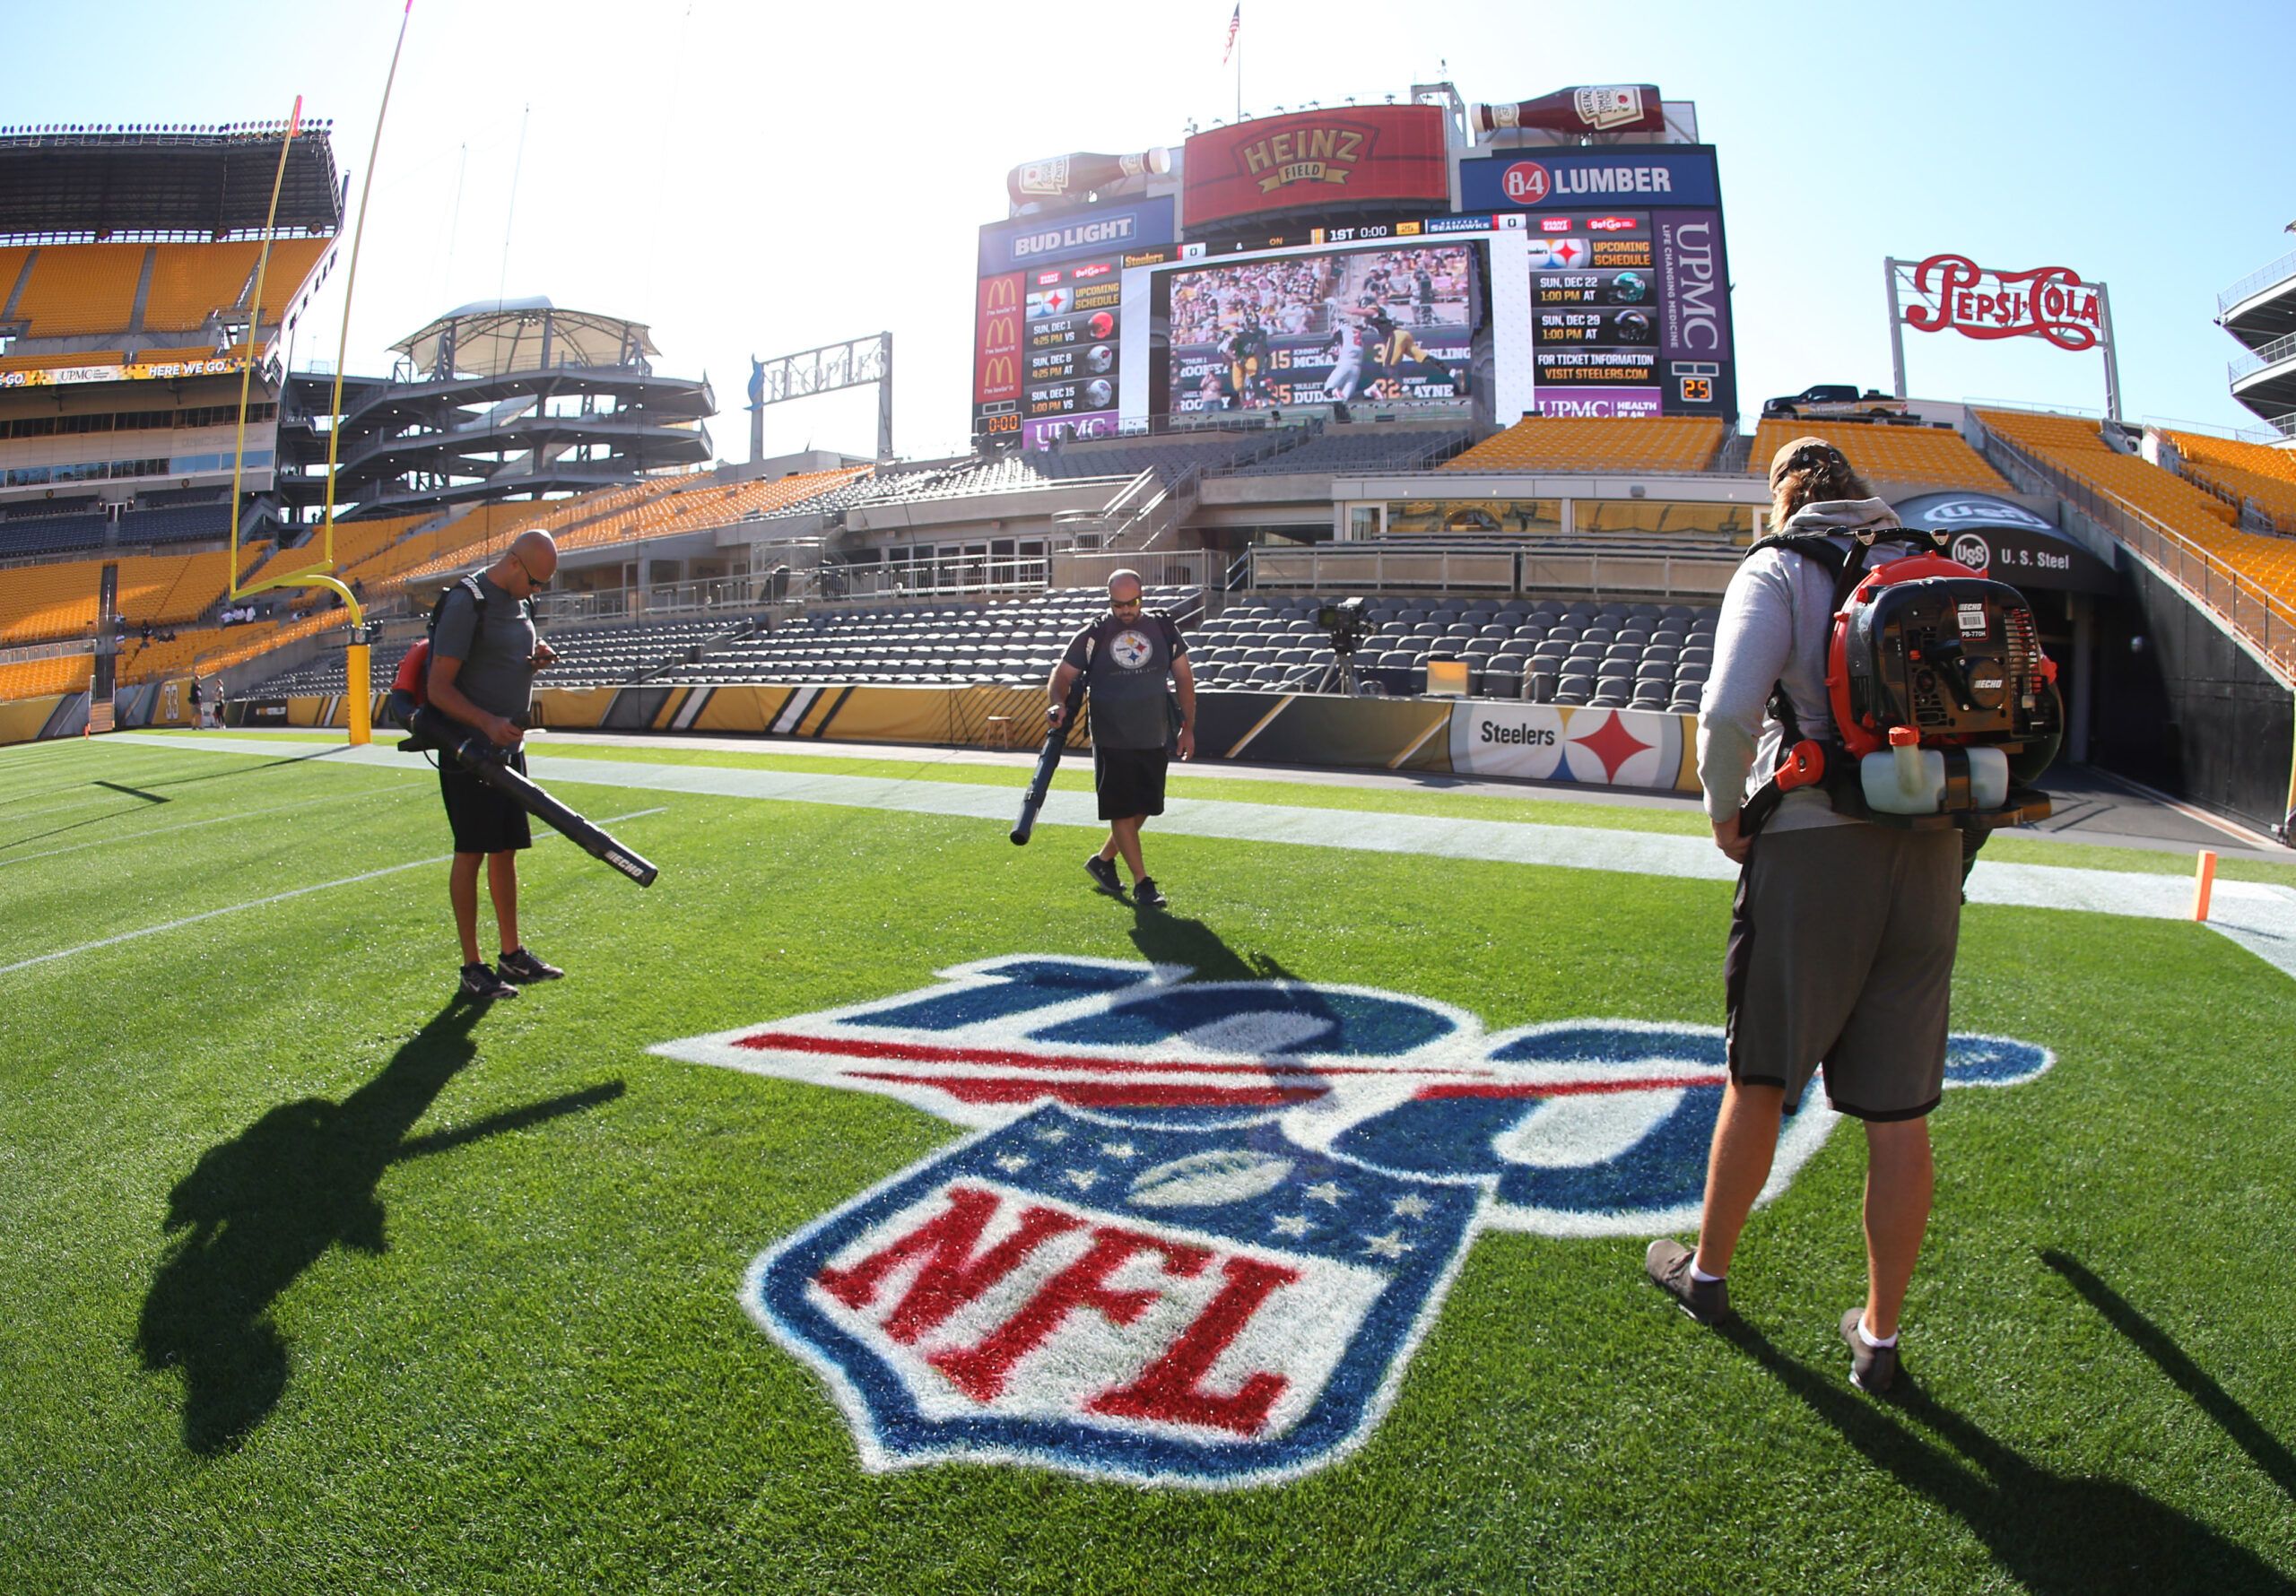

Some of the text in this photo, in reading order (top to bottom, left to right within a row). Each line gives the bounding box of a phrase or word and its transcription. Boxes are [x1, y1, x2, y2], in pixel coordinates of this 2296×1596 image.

[1243, 129, 1364, 175] HEINZ
[1284, 163, 1320, 179] FIELD
[1507, 168, 1672, 196] 84 LUMBER
[1330, 226, 1387, 241] 1ST 0:00
[1430, 222, 1491, 233] SEAHAWKS
[1015, 219, 1132, 256] BUD LIGHT
[1269, 237, 1283, 247] ON
[1593, 242, 1650, 252] UPCOMING
[1126, 253, 1164, 267] Steelers
[1594, 255, 1651, 265] SCHEDULE
[1075, 282, 1119, 298] UPCOMING
[1540, 277, 1598, 289] SUN, DEC 22
[1662, 224, 1679, 349] LIFE CHANGING MEDICINE
[1676, 221, 1718, 350] UPMC
[1075, 294, 1119, 309] SCHEDULE
[1541, 291, 1596, 301] 1:00 PM AT
[1542, 315, 1600, 326] SUN, DEC 29
[1033, 324, 1050, 334] SUN,
[1052, 322, 1065, 332] DEC
[1543, 329, 1597, 340] 1:00 PM AT
[1033, 332, 1075, 345] 4:25 PM VS
[1032, 357, 1049, 368] SUN,
[1051, 355, 1065, 364] DEC
[1270, 350, 1291, 369] 15
[1538, 354, 1654, 365] FOR TICKET INFORMATION
[61, 369, 93, 381] UPMC
[149, 360, 228, 377] HERE WE GO.
[1032, 366, 1074, 378] 4:25 PM AT
[1544, 369, 1648, 379] VISIT STEELERS.COM
[771, 350, 887, 402] PEOPLES
[1031, 387, 1074, 402] SUN, DEC 15
[1413, 384, 1455, 398] AYNE
[1684, 379, 1709, 398] 25
[1032, 400, 1074, 412] 1:00 PM VS
[1537, 400, 1657, 418] UPMC HEALTH
[989, 415, 1018, 432] 0:00
[2002, 549, 2016, 564] U.
[2020, 551, 2033, 566] S.
[2038, 552, 2070, 569] Steel
[1964, 603, 1983, 611] ECHO
[1980, 680, 2003, 689] ECHO
[1481, 720, 1555, 746] Steelers
[610, 854, 645, 878] ECHO
[817, 1182, 1304, 1439] NFL
